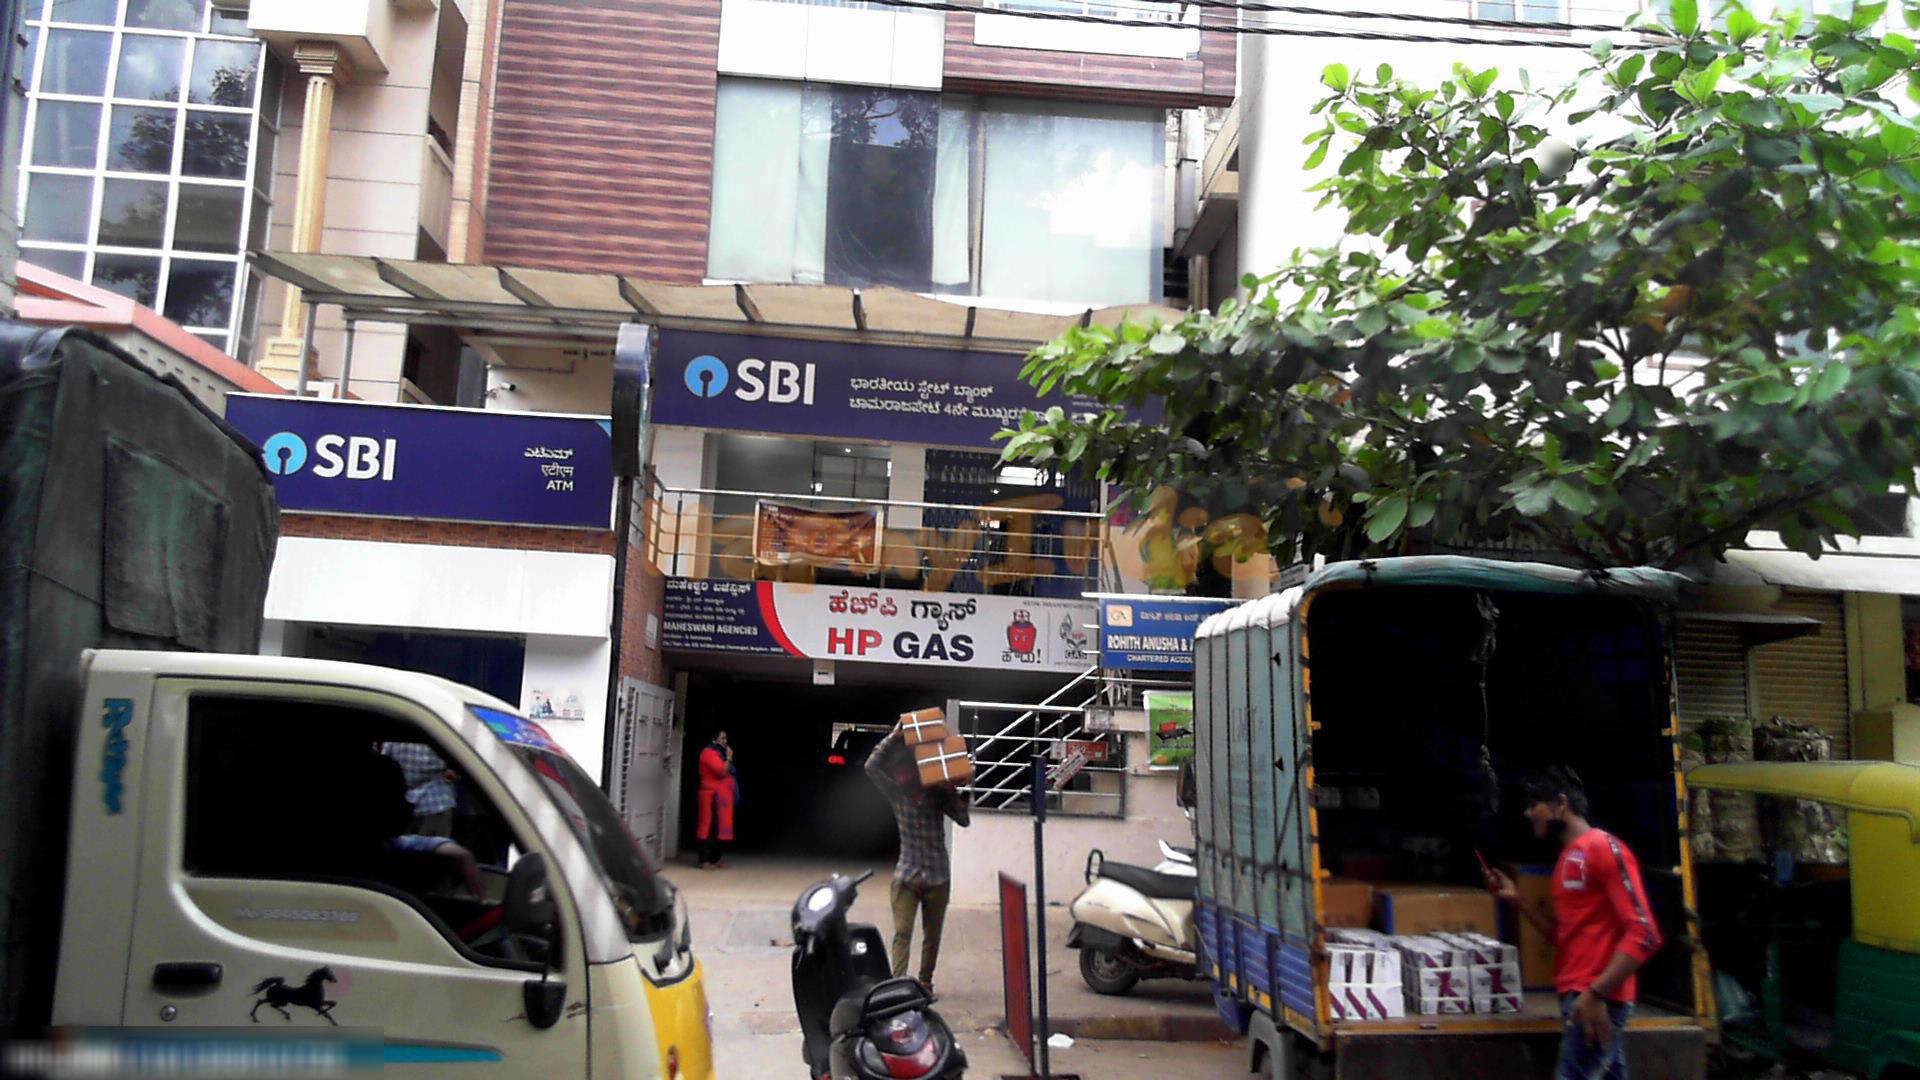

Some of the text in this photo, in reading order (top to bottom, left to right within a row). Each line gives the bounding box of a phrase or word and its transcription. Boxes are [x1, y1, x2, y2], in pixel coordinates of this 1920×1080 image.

[734, 358, 816, 405] SBI
[850, 377, 994, 403] ಭಾರತೀಯ ಸ್ಟೇಟ್ ಬ್ಯಾಂಕ್
[312, 434, 397, 481] SBI
[541, 462, 574, 477] एटीएम
[546, 480, 574, 491] ATM
[910, 598, 977, 631] ಗ್ಯಾಸ್
[663, 622, 758, 636] MAHESWARI AGENCIES
[827, 627, 974, 662] HP GAS
[1107, 634, 1140, 650] ROHITH
[1142, 636, 1179, 651] ANUSHA
[1181, 638, 1188, 651] &
[1127, 654, 1169, 663] CHARTERED
